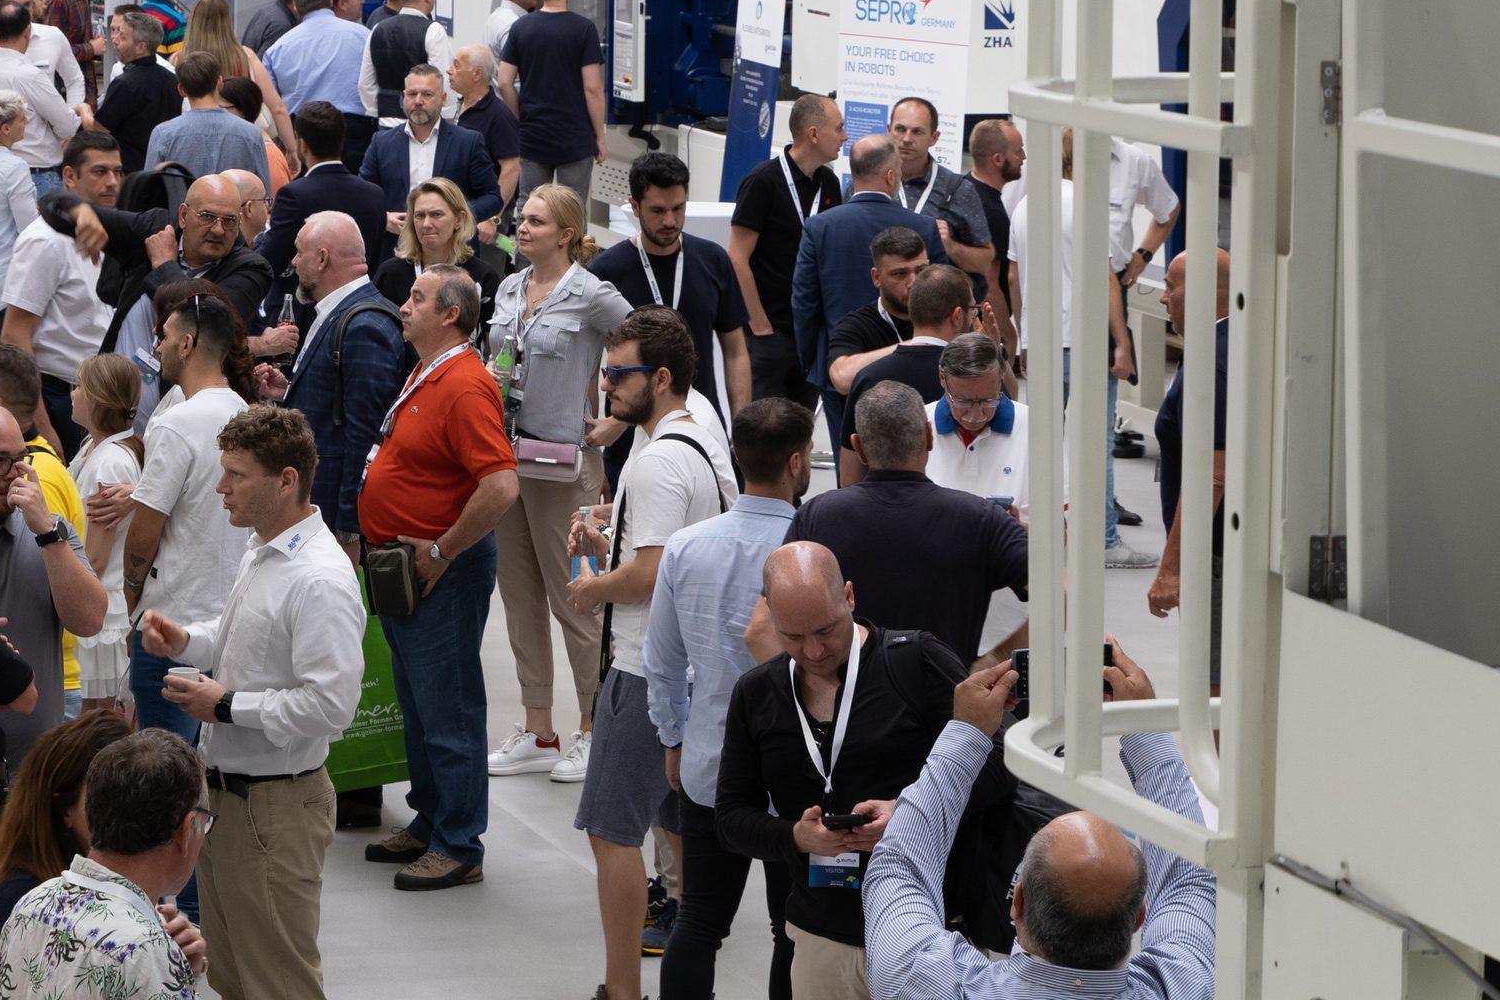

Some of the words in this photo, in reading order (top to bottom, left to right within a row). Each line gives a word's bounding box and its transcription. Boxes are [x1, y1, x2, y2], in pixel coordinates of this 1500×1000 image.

[921, 17, 957, 29] GERMANY
[984, 36, 1013, 48] ZHA
[846, 44, 872, 57] YOUR
[874, 47, 897, 60] FREE
[900, 50, 935, 64] CHOICE
[845, 62, 855, 72] IN
[858, 63, 895, 76] ROBOTS
